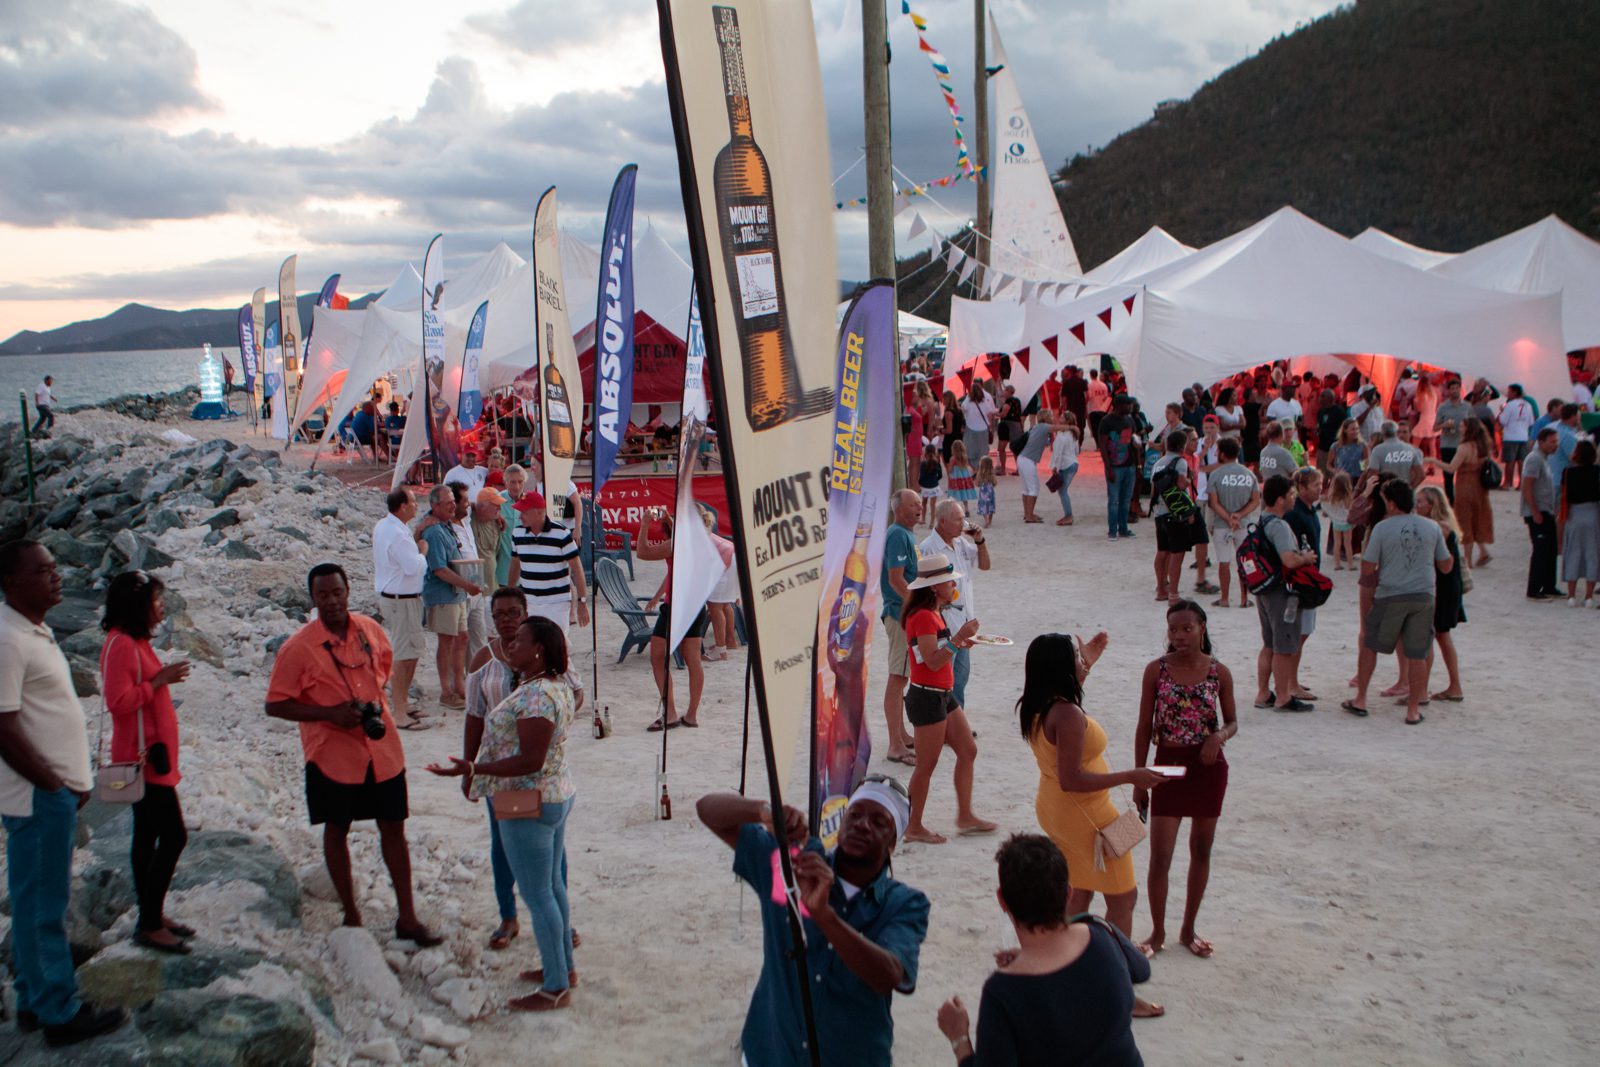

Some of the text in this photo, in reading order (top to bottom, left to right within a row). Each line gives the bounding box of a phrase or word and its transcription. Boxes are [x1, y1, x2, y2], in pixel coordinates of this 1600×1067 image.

[729, 205, 756, 225] MOUNT
[599, 233, 626, 446] ABSOLUT
[653, 343, 678, 358] GAY
[831, 331, 865, 492] REAL BEER
[1259, 456, 1277, 469] 528
[1385, 450, 1414, 463] 4528
[849, 475, 862, 495] IS
[1221, 474, 1254, 487] 4528
[752, 471, 814, 529] MOUNT
[601, 507, 622, 525] AY
[766, 515, 808, 560] 1703
[796, 567, 820, 586] TIME
